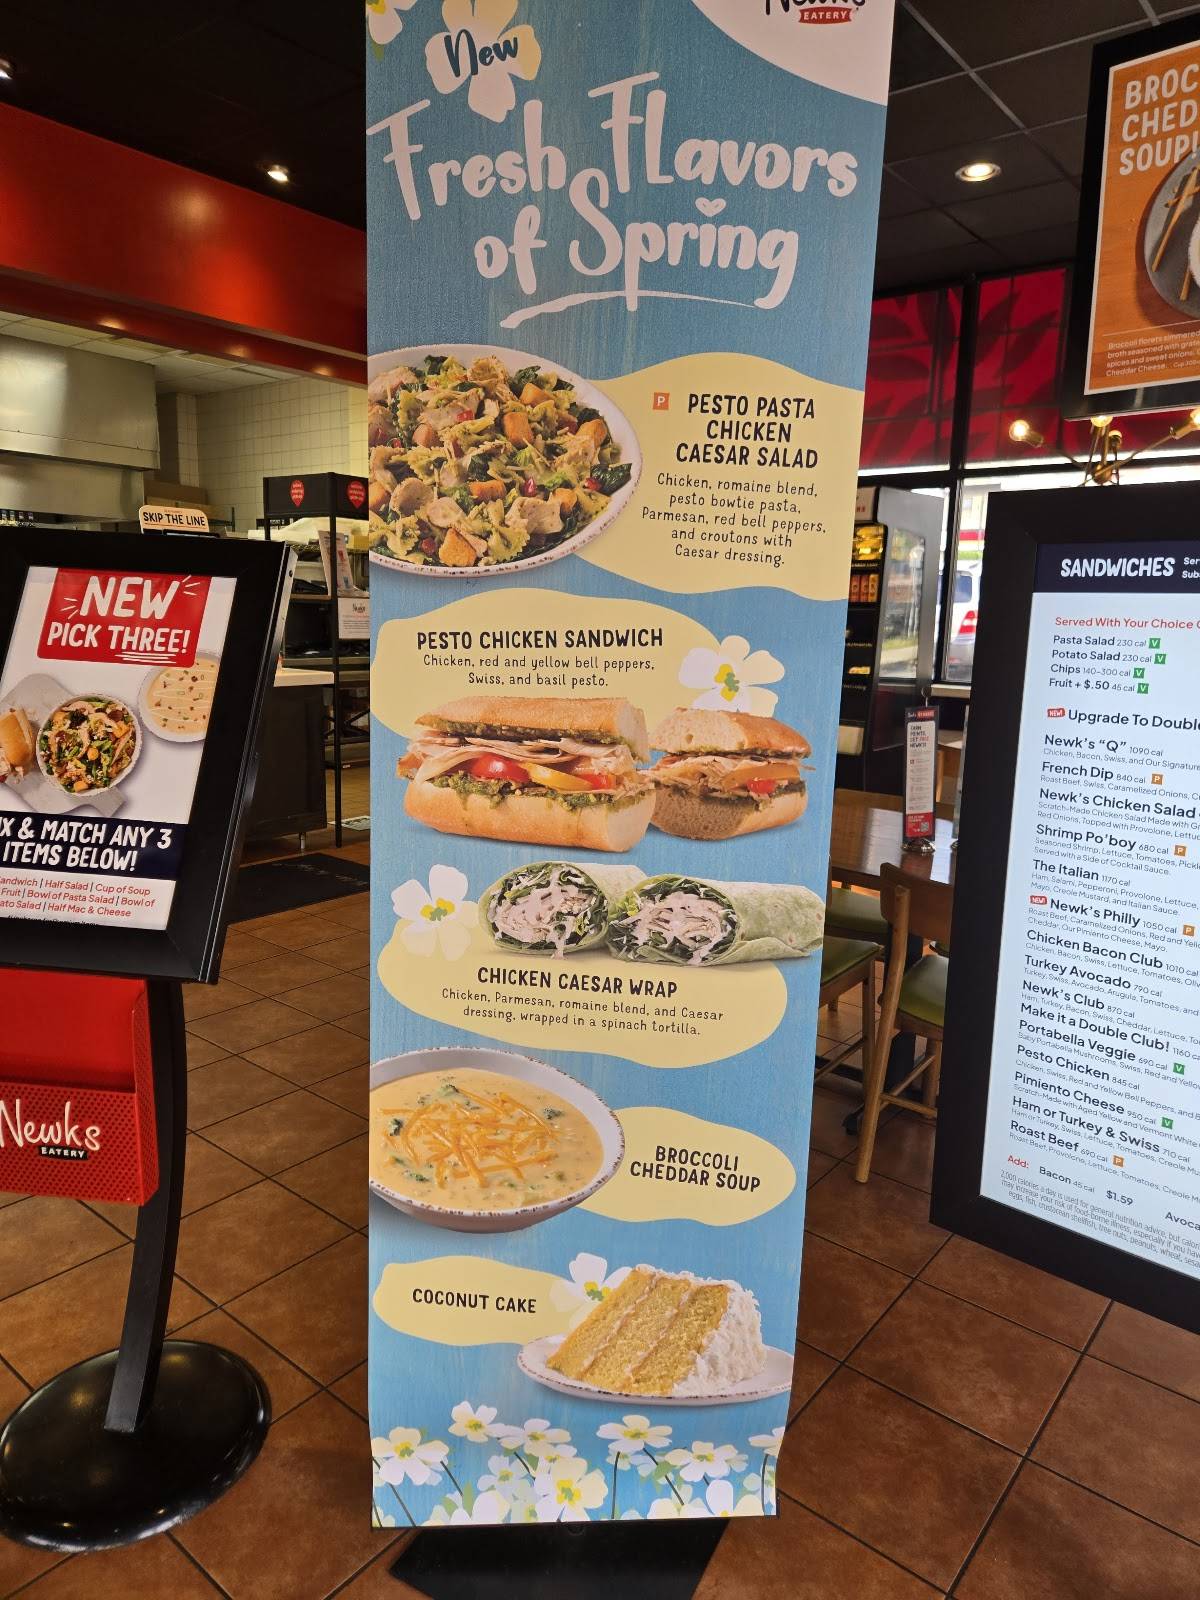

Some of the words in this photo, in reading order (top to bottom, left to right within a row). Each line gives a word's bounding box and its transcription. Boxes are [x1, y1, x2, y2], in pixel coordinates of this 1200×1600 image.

[804, 11, 848, 20] EATERY
[444, 29, 518, 77] New
[366, 99, 566, 220] Fresh
[1120, 131, 1198, 175] SOUP!
[475, 205, 547, 294] of
[569, 168, 798, 311] Spring
[688, 393, 749, 415] PESTO
[756, 397, 815, 419] PASTA
[706, 419, 792, 443] CHICKEN
[676, 442, 750, 466] CAESAR
[756, 446, 818, 468] SALAD
[657, 473, 712, 490] Chicken,
[717, 479, 771, 493] romaine
[777, 480, 818, 497] blend,
[669, 492, 705, 508] pesto
[711, 494, 754, 509] bowtie
[760, 499, 801, 514] pasta,
[143, 512, 163, 522] SKIP
[165, 514, 184, 524] THE
[186, 516, 206, 526] LINE
[642, 506, 709, 525] Parmesan,
[714, 513, 735, 526] red
[741, 514, 766, 528] bell
[772, 518, 826, 534] peppers,
[671, 528, 695, 540] and
[700, 530, 758, 545] croutons
[763, 534, 792, 547] with
[675, 544, 719, 559] Caesar
[724, 547, 785, 568] dressing.
[1060, 557, 1175, 577] SANDWICHES
[79, 575, 180, 620] NEW
[1055, 617, 1093, 627] Served
[1095, 617, 1121, 627] With
[1123, 618, 1148, 628] Your
[1151, 618, 1193, 629] Choice
[46, 621, 102, 648] PICK
[108, 625, 191, 654] THREE!
[417, 631, 472, 650] PESTO
[479, 630, 557, 649] CHICKEN
[564, 628, 663, 648] SANDWICH
[1053, 635, 1082, 645] Pasta
[1084, 636, 1115, 646] Salad
[423, 654, 475, 668] Chicken,
[479, 657, 499, 667] red
[504, 657, 526, 668] and
[531, 656, 570, 671] yellow
[575, 656, 599, 669] bell
[603, 658, 655, 672] peppers,
[1052, 650, 1088, 660] Potato
[1090, 650, 1121, 661] Salad
[1122, 654, 1139, 662] 230
[1140, 655, 1152, 663] cal
[468, 672, 505, 685] Swiss,
[509, 674, 531, 685] and
[536, 674, 566, 686] basil
[571, 674, 609, 689] pesto.
[1049, 678, 1072, 688] Fruit
[1084, 679, 1110, 690] $.50
[1068, 709, 1129, 725] Upgrade
[1132, 714, 1148, 726] To
[1044, 734, 1095, 749] Newk's
[1129, 747, 1149, 755] 1090
[1042, 761, 1087, 777] French
[1090, 767, 1114, 781] Dip
[1039, 788, 1089, 805] Newk's
[1093, 795, 1150, 812] Chicken
[1154, 802, 1196, 818] Salad
[17, 816, 35, 840] &
[40, 819, 107, 844] MATCH
[109, 824, 154, 848] ANY
[157, 829, 173, 850] 3
[1036, 823, 1083, 842] Shrimp
[1085, 831, 1136, 851] Po'boy
[1138, 844, 1155, 853] 680
[1156, 847, 1169, 855] cal
[2, 841, 62, 866] ITEMS
[66, 846, 138, 872] BELOW!
[1033, 859, 1056, 873] The
[1058, 863, 1099, 881] Italian
[1, 888, 21, 896] Fruit
[27, 890, 50, 898] Bowl
[52, 892, 62, 900] of
[63, 893, 86, 901] Pasta
[89, 894, 114, 904] Salad
[121, 897, 143, 906] Bowl
[145, 899, 155, 907] of
[45, 880, 64, 889] Half
[65, 882, 88, 890] Salad
[96, 884, 114, 893] Cup
[128, 886, 150, 896] Soup
[1050, 898, 1100, 918] Newk's
[1103, 909, 1141, 928] Philly
[1027, 929, 1080, 951] Chicken
[1082, 942, 1127, 961] Bacon
[1129, 952, 1163, 969] Club
[477, 966, 551, 988] CHICKEN
[558, 973, 623, 994] CAESAR
[629, 978, 678, 998] WRAP
[1025, 954, 1067, 976] Turkey
[1069, 966, 1131, 989] Avocado
[442, 988, 491, 1003] Chicken,
[495, 992, 555, 1008] Parmesan,
[559, 998, 608, 1012] romaine
[613, 1002, 650, 1016] blend,
[654, 1005, 676, 1017] and
[681, 1007, 724, 1022] Caesar
[1023, 980, 1071, 1001] Newk's
[1074, 993, 1105, 1010] Club
[463, 1006, 516, 1024] dressing,
[520, 1011, 568, 1026] wrapped
[573, 1015, 585, 1026] in
[589, 1018, 597, 1028] a
[601, 1017, 647, 1032] spinach
[652, 1020, 701, 1036] tortilla.
[1020, 1002, 1055, 1020] Make
[1057, 1012, 1066, 1024] it
[1068, 1017, 1076, 1026] a
[1079, 1018, 1128, 1041] Double
[1131, 1032, 1170, 1052] Club!
[1019, 1019, 1085, 1047] Portabella
[1087, 1038, 1136, 1061] Veggie
[1017, 1044, 1053, 1064] Pesto
[1055, 1056, 1110, 1081] Chicken
[1015, 1071, 1071, 1097] Pimiento
[1073, 1090, 1125, 1114] Cheese
[0, 1098, 100, 1151] Newks
[1010, 1120, 1046, 1141] Roast
[1048, 1133, 1079, 1152] Beef
[1012, 1096, 1041, 1113] Ham
[1043, 1108, 1057, 1119] or
[1059, 1110, 1103, 1136] Turkey
[1106, 1127, 1115, 1138] &
[1119, 1131, 1160, 1153] Swiss
[41, 1147, 85, 1158] EATERY
[655, 1145, 739, 1172] BROCCOLI
[1007, 1155, 1030, 1168] Add:
[630, 1161, 710, 1185] CHEDDAR
[716, 1172, 760, 1192] SOUP
[1039, 1165, 1071, 1185] Bacon
[1106, 1190, 1133, 1206] $1.59
[412, 1288, 490, 1310] COCONUT
[495, 1296, 537, 1313] CAKE
